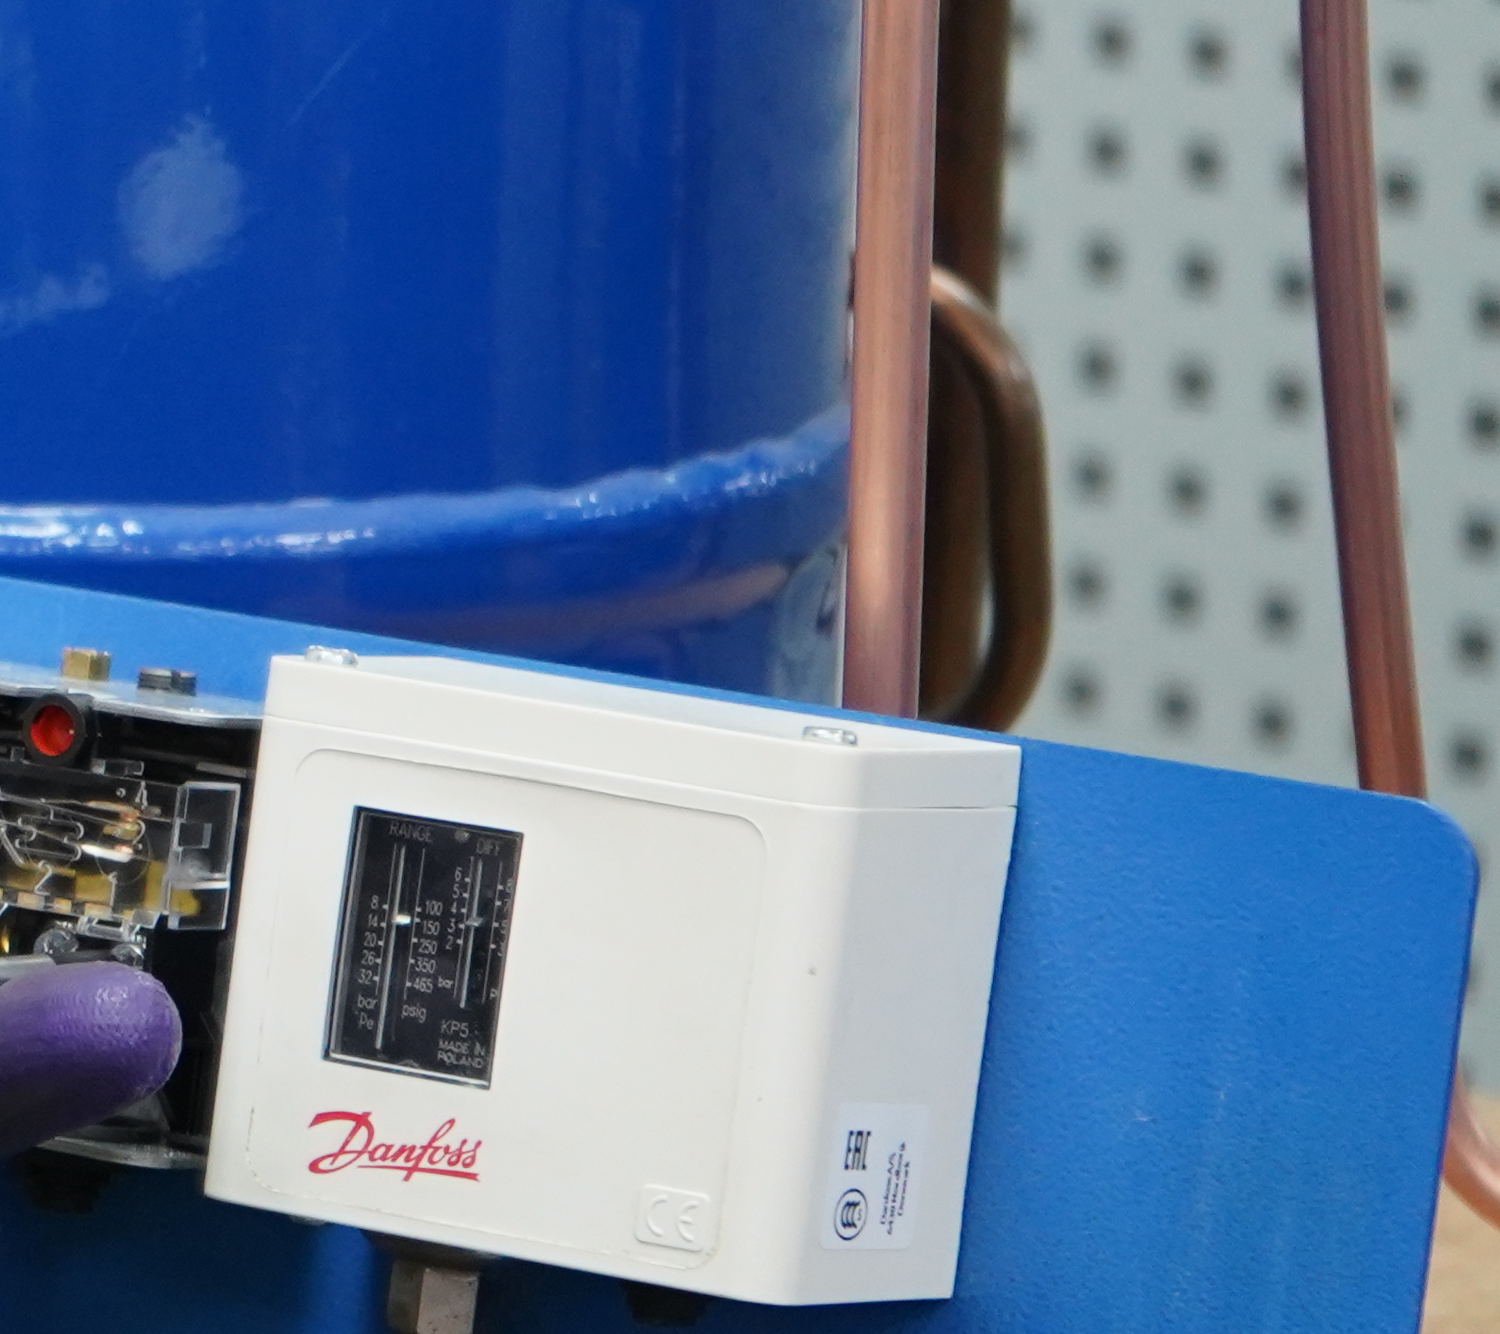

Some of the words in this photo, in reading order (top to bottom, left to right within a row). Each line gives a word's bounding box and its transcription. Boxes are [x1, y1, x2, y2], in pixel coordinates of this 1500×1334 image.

[388, 821, 432, 842] RANGE
[34, 859, 53, 895] 2
[455, 866, 462, 882] 6
[452, 883, 460, 899] 5
[371, 895, 379, 909] 8
[425, 900, 443, 916] 100
[450, 900, 457, 914] 4
[368, 913, 378, 927] 14
[422, 920, 440, 936] 150
[447, 918, 456, 933] 3
[364, 932, 377, 947] 20
[418, 938, 438, 955] 250
[445, 935, 453, 950] 2
[361, 950, 375, 966] 26
[415, 957, 436, 974] 350
[357, 969, 373, 985] 32
[413, 977, 433, 993] 465
[438, 976, 454, 990] bar
[357, 993, 378, 1010] bar
[401, 1003, 427, 1023] psig
[440, 1019, 469, 1038] KP5
[438, 1038, 469, 1054] MADE
[474, 1042, 485, 1056] IN
[437, 1050, 484, 1068] POLAND
[308, 1111, 482, 1182] Danfoss
[844, 1130, 871, 1170] EAC
[646, 1194, 699, 1243] CE
